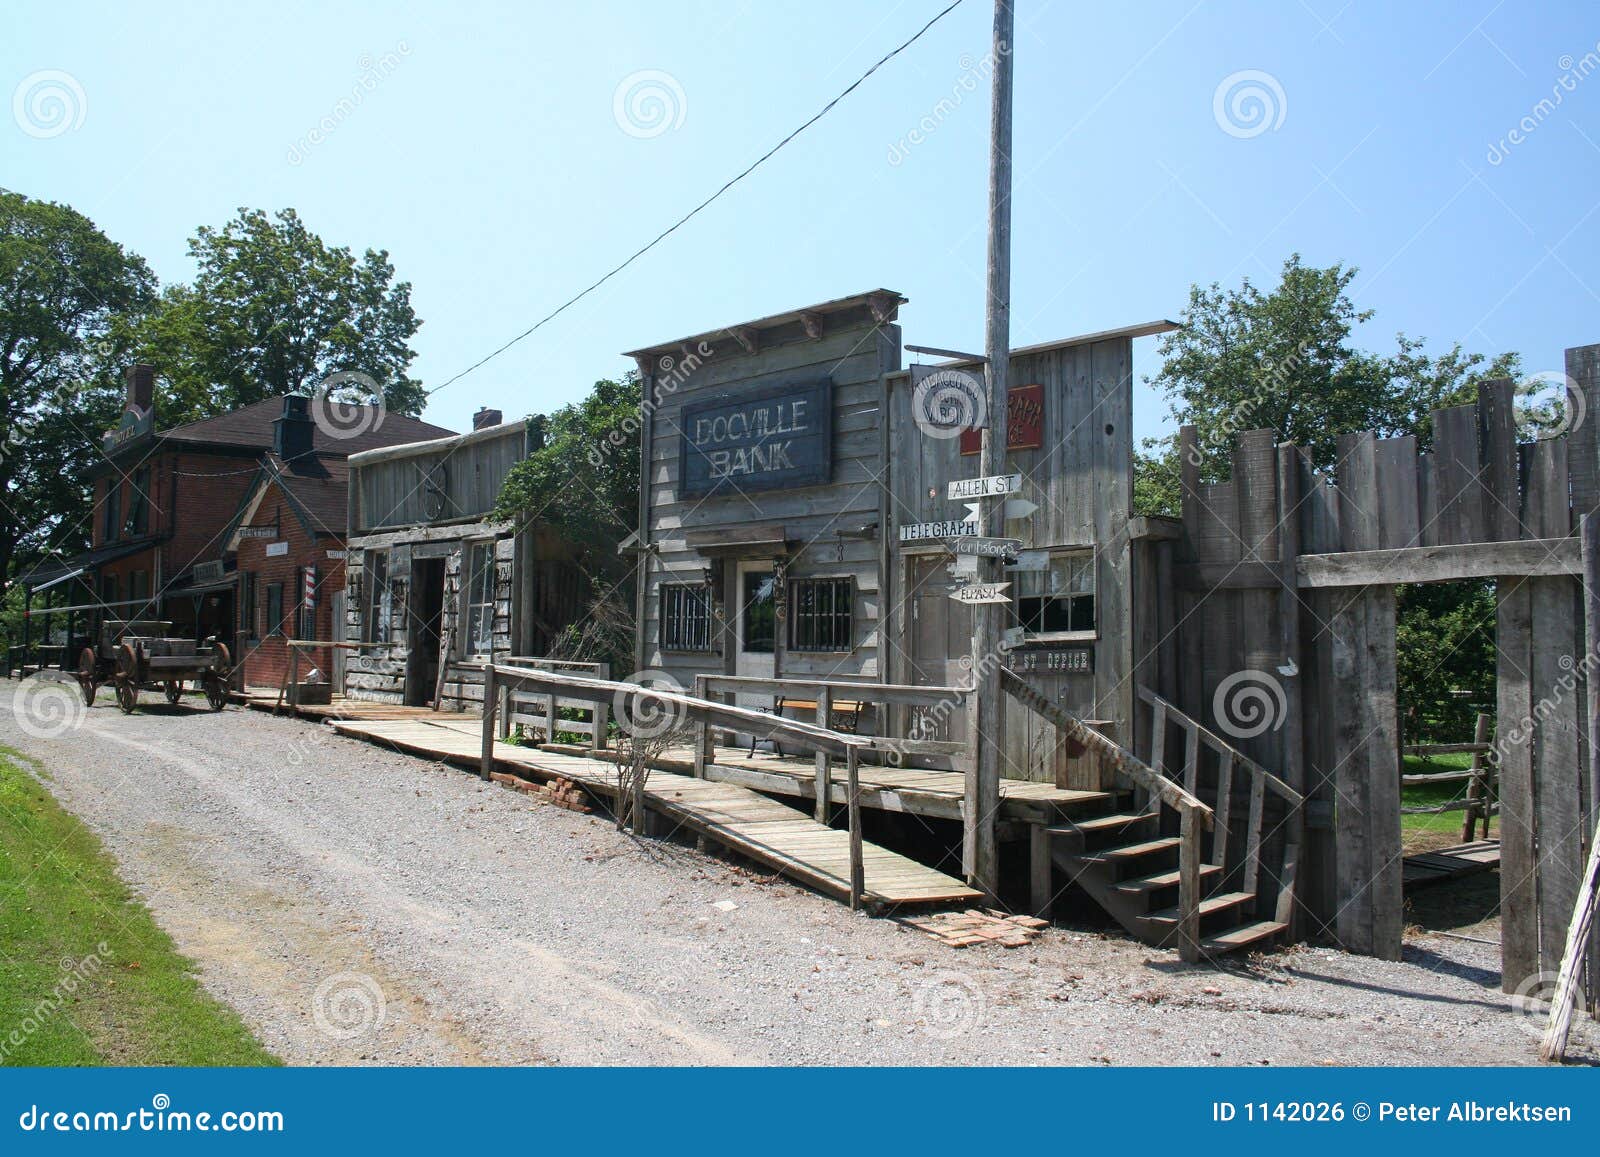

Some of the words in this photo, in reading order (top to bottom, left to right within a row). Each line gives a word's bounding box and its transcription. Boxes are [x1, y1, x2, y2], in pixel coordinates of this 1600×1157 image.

[695, 399, 809, 447] DOCVILLE
[709, 440, 795, 479] BANK
[953, 479, 989, 498] ALLEN
[903, 521, 976, 540] TELEGRAPH
